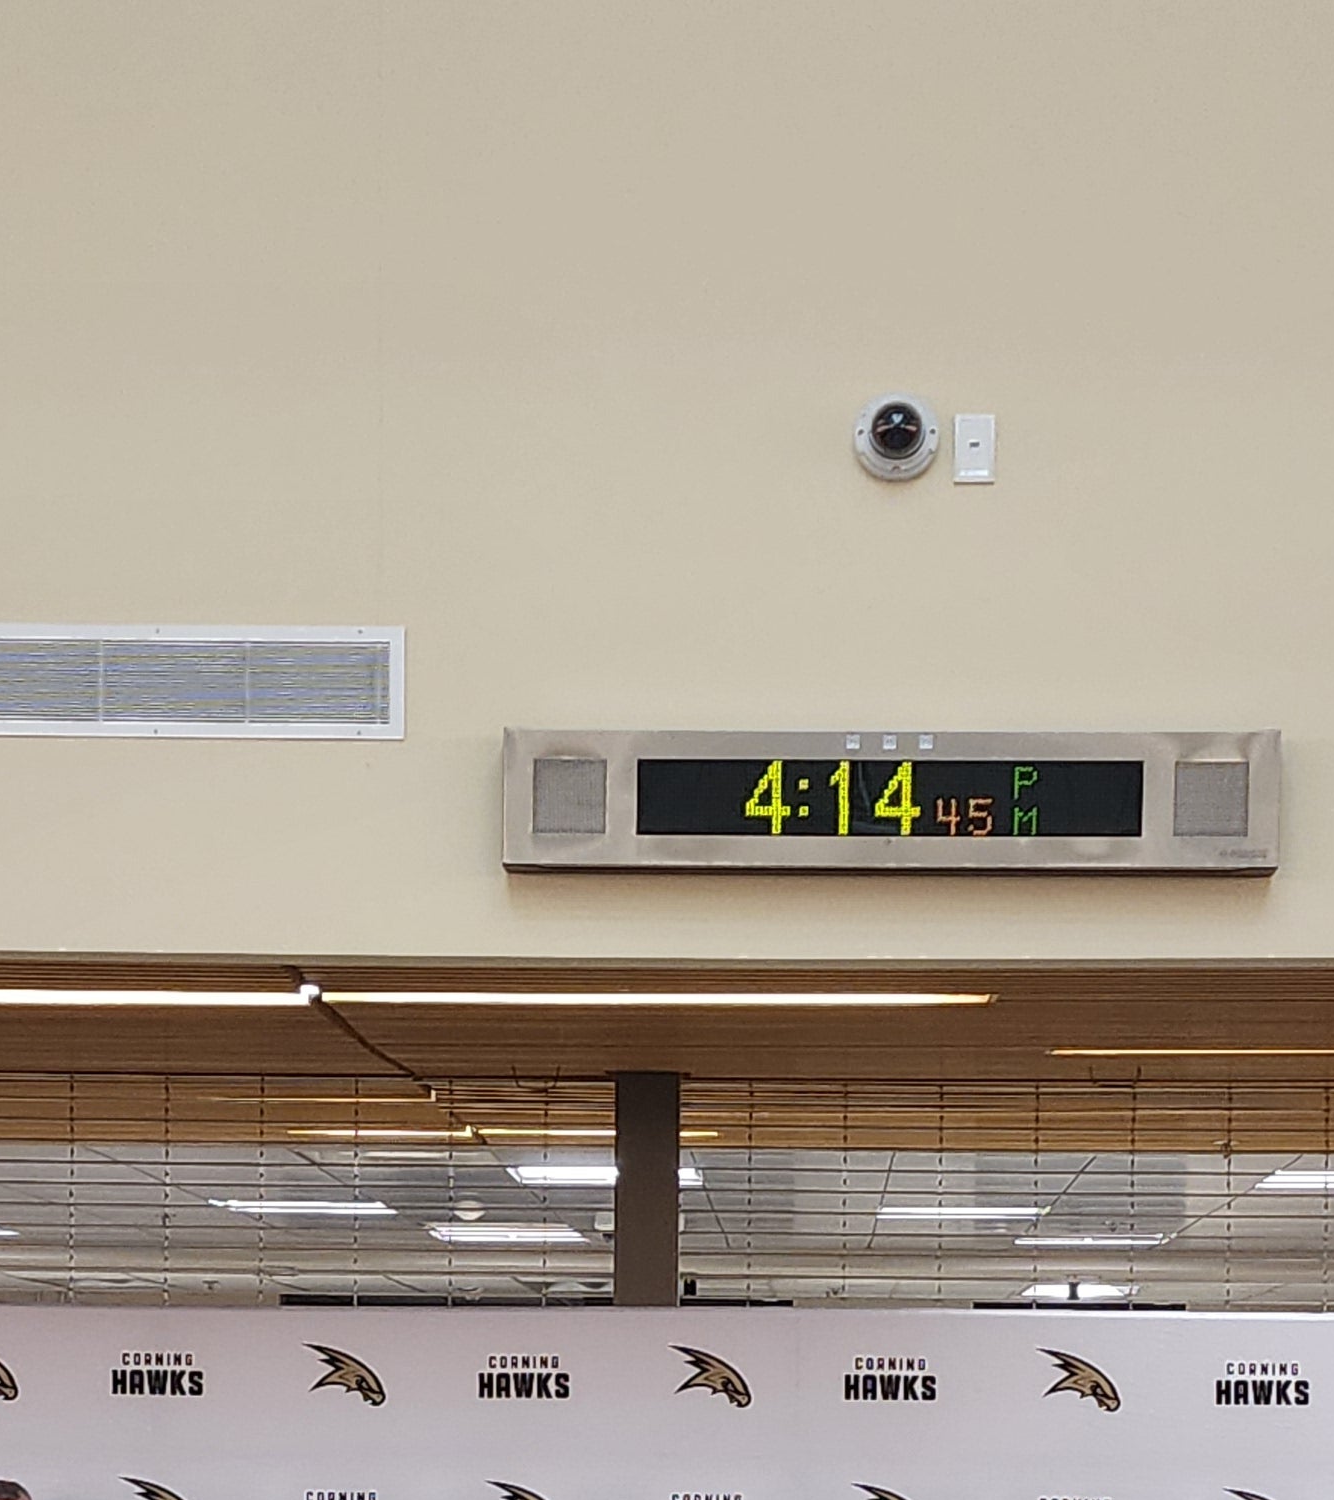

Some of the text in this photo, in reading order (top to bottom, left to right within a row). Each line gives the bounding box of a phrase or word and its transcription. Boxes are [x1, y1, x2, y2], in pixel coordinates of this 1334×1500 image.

[745, 759, 921, 836] 4:14
[936, 797, 993, 837] 45
[122, 1352, 192, 1366] CORNING
[488, 1355, 559, 1369] CORNING
[855, 1357, 926, 1371] CORNING
[1226, 1362, 1299, 1376] CORNING
[111, 1369, 203, 1396] HAWKS
[478, 1372, 569, 1399] HAWKS
[844, 1374, 936, 1401] HAWKS
[1215, 1379, 1310, 1406] HAWKS
